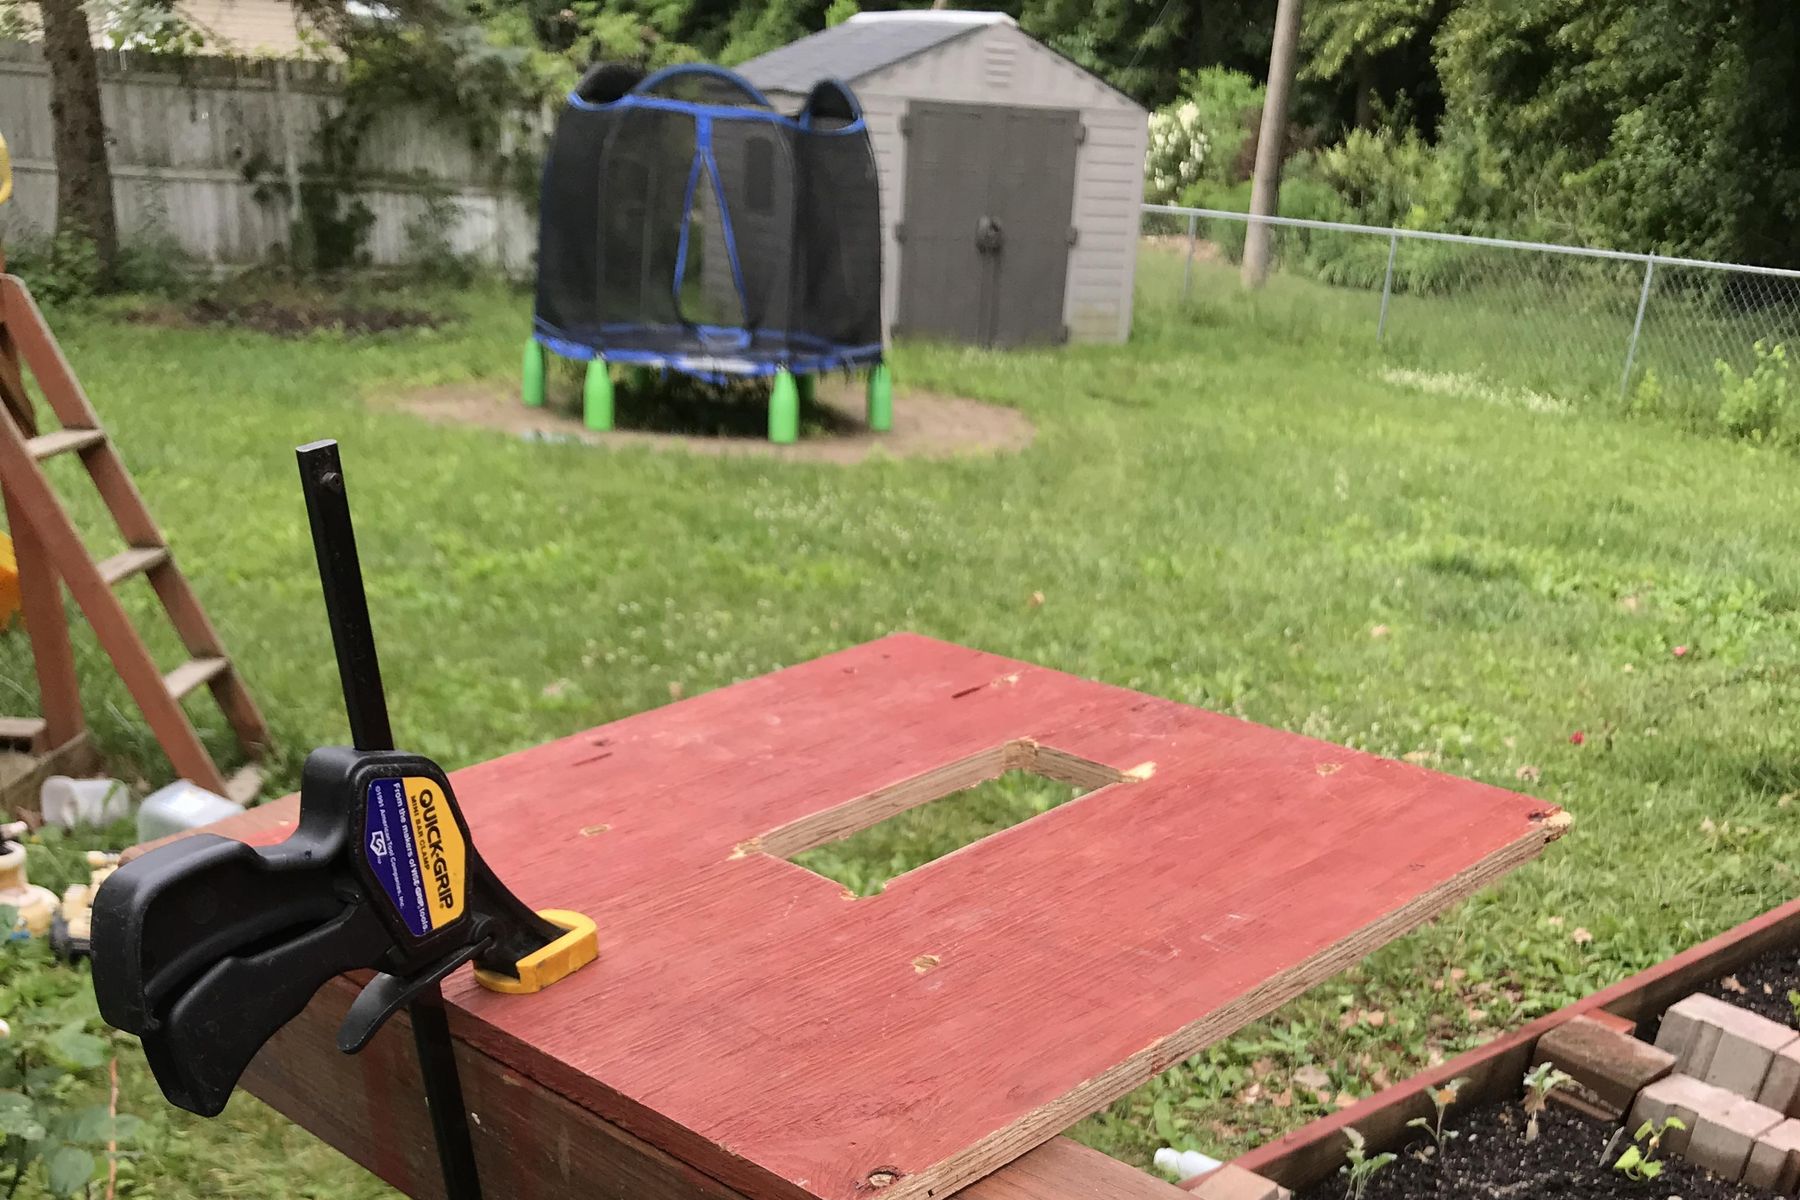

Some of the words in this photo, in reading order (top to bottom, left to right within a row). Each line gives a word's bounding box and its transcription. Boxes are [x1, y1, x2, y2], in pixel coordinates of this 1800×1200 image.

[393, 782, 403, 807] From
[410, 795, 420, 817] MINI
[399, 808, 407, 824] the
[380, 808, 391, 843] American
[387, 840, 395, 857] Tool
[415, 818, 424, 838] BAR
[402, 824, 413, 857] makers
[409, 858, 417, 868] of
[419, 839, 430, 870] CLAMP
